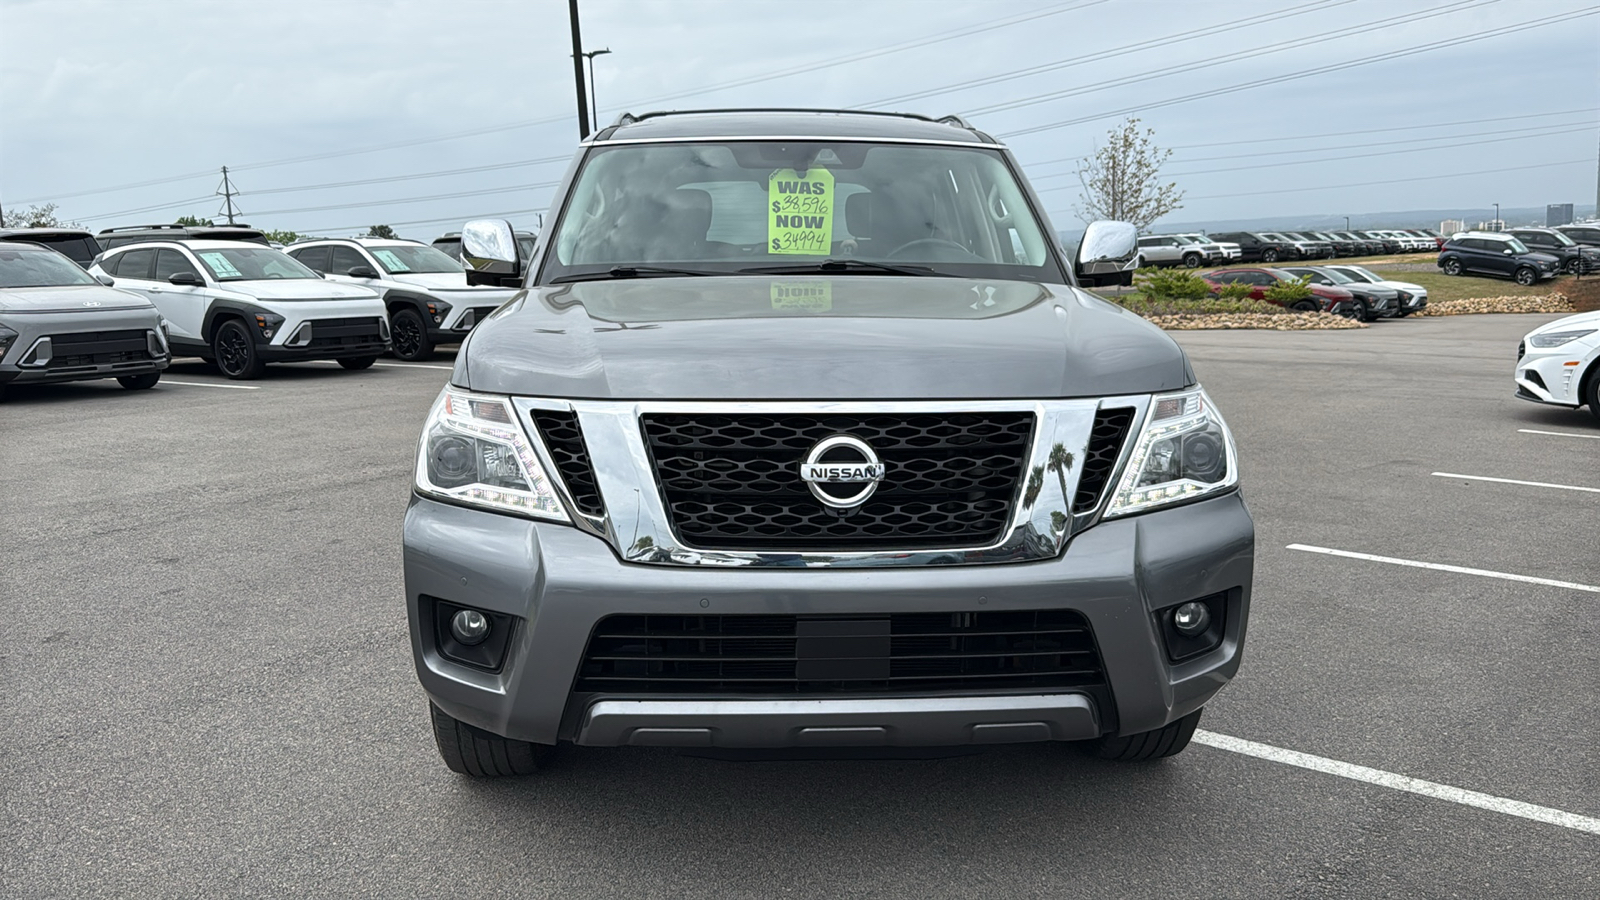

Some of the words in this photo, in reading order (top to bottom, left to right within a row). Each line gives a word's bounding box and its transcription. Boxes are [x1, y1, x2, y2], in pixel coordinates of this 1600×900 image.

[777, 181, 825, 195] WAS
[776, 215, 825, 229] NOW
[811, 468, 876, 478] NISSAN
